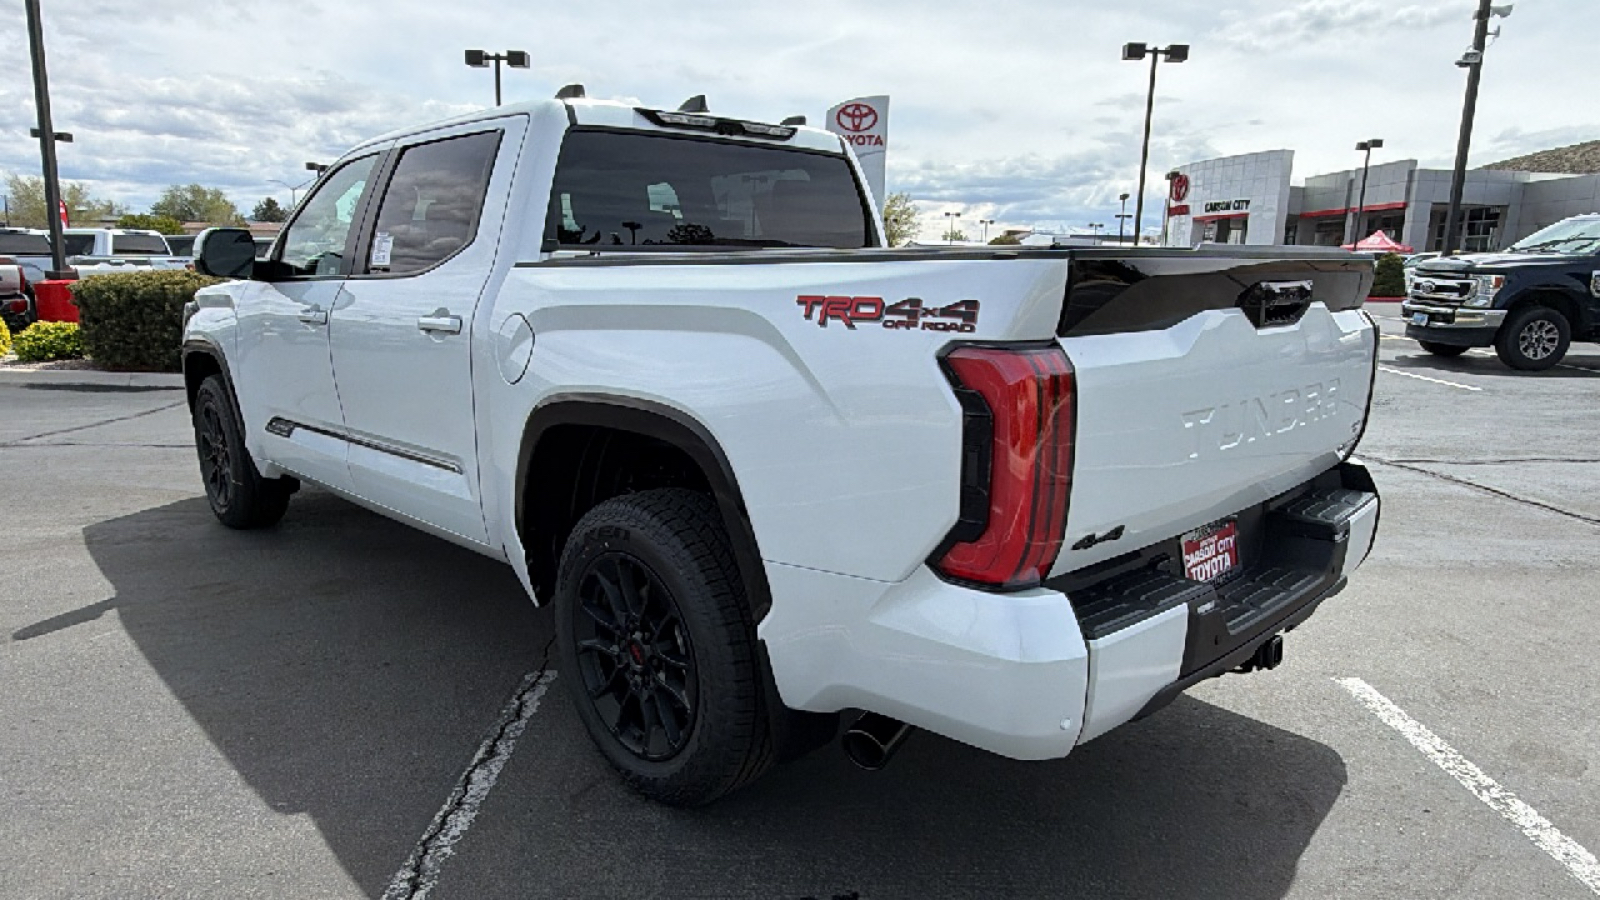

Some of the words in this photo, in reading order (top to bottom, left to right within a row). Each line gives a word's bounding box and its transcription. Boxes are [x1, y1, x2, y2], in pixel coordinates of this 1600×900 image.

[843, 134, 884, 146] YOTA
[1232, 199, 1251, 211] CITY
[796, 295, 886, 330] TRD
[882, 319, 919, 330] OFF
[920, 321, 976, 333] ROAD
[1181, 377, 1341, 459] TUNDRA
[1184, 544, 1216, 569] CARSON
[1217, 534, 1236, 554] CITY
[1190, 551, 1231, 582] TOYOTA
